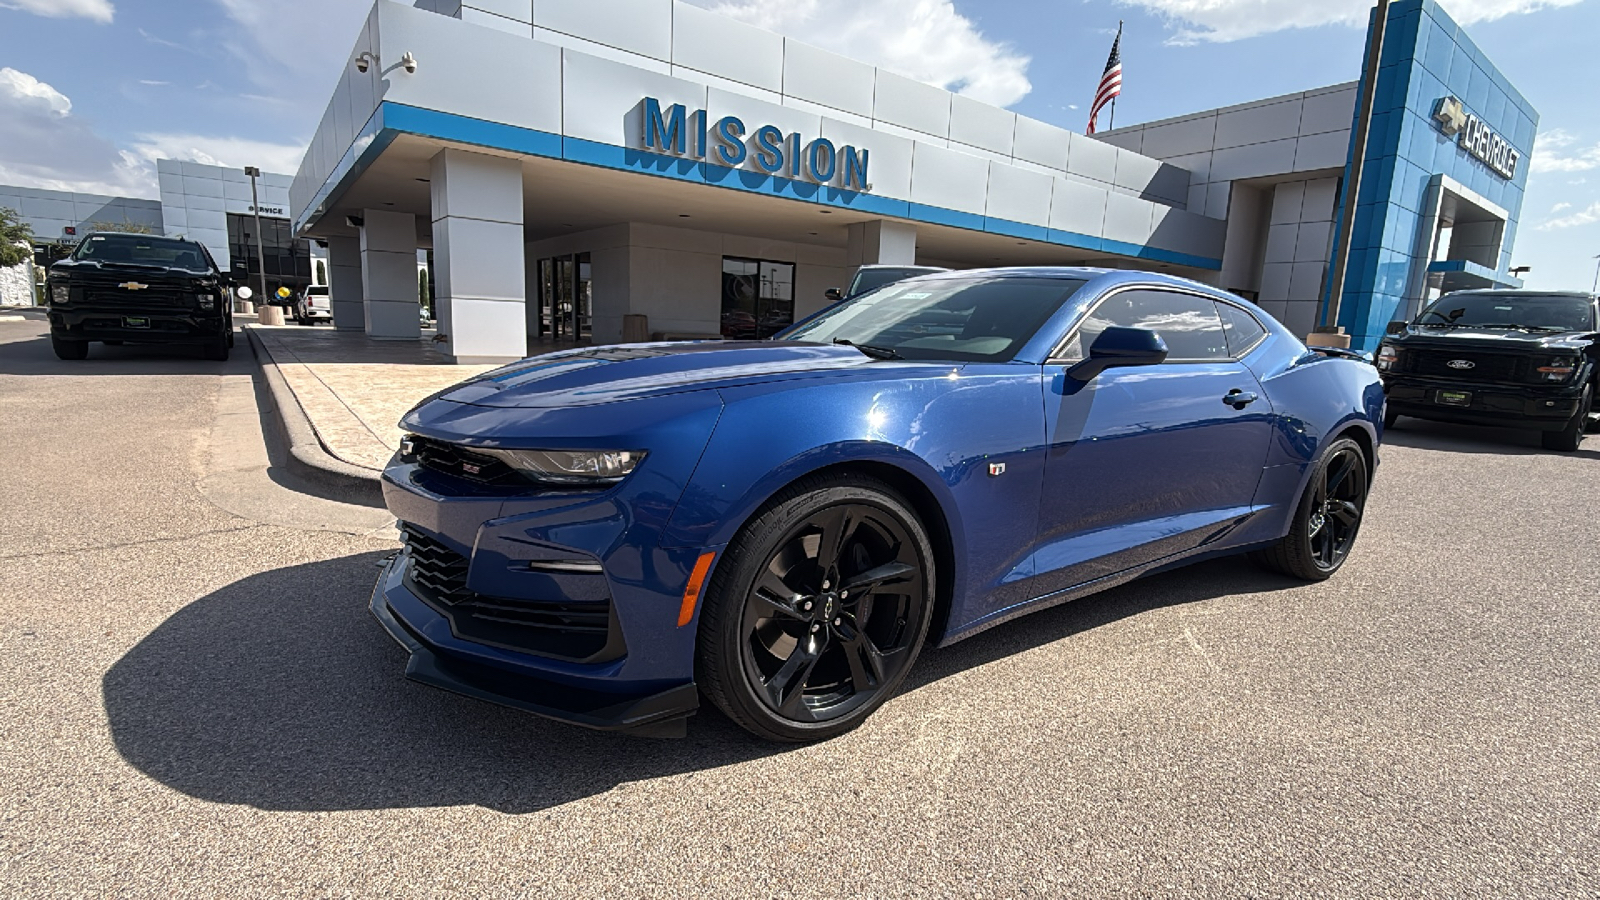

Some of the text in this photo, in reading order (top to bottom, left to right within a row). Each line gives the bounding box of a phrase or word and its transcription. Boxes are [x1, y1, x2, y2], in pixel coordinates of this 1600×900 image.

[643, 96, 870, 191] MISSION
[1464, 113, 1520, 179] CHEVROLET
[248, 205, 283, 214] SRVICE
